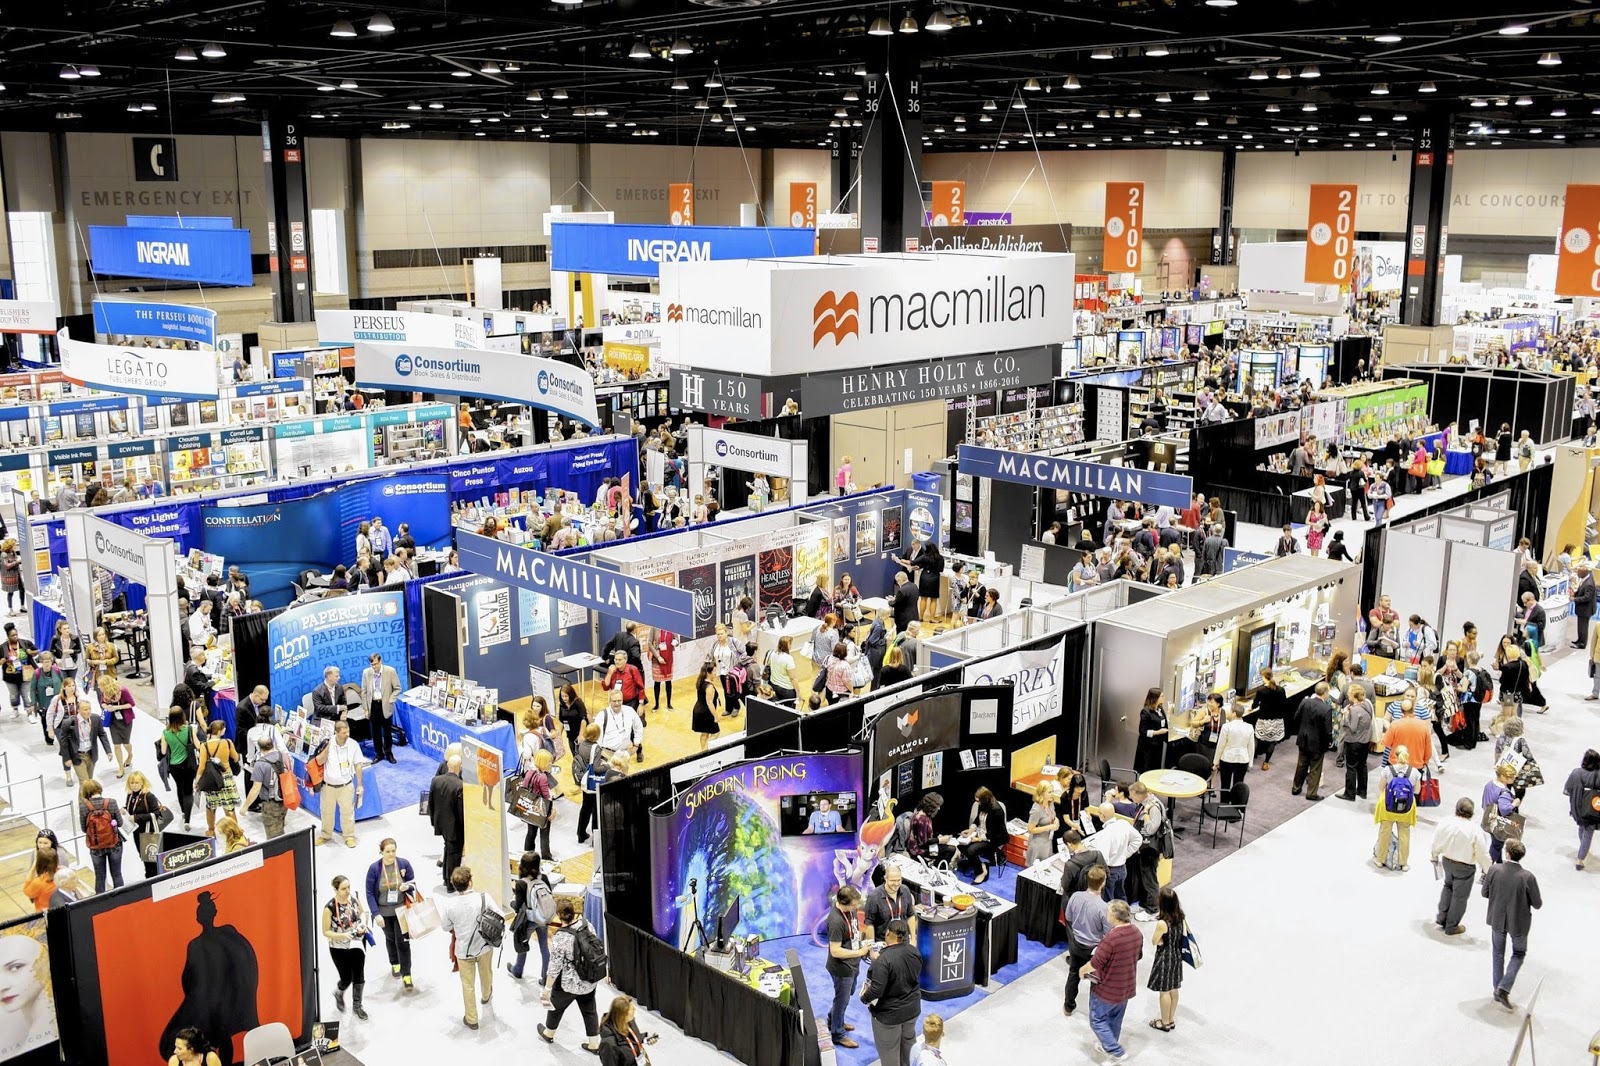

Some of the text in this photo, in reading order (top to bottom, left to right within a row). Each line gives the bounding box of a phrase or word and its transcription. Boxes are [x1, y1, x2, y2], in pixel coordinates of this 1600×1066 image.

[868, 81, 876, 94] H
[910, 81, 918, 95] H
[865, 99, 878, 113] 36
[908, 99, 920, 113] 36
[287, 125, 295, 134] D
[1423, 128, 1430, 138] H
[286, 136, 297, 146] 36
[1420, 140, 1431, 149] 32
[82, 190, 251, 206] EMERGENCY EXIT
[696, 189, 720, 200] EXIT
[1378, 194, 1396, 206] TO
[1480, 194, 1566, 208] CONCOURS
[1126, 187, 1140, 268] 2100
[1333, 190, 1352, 280] 2000
[137, 241, 190, 266] INGRAM
[627, 238, 710, 262] INGRAM
[870, 275, 1045, 334] macmillan
[135, 310, 204, 326] THE PERSEUS BOOKS
[354, 316, 405, 330] PERSEUS
[686, 306, 762, 329] macmillan
[355, 332, 406, 341] DISTRIBUTION
[108, 358, 168, 378] LEGATO
[414, 355, 480, 374] Consortium
[109, 374, 167, 388] PUBLISHERS GROUP
[414, 368, 426, 377] Book
[429, 370, 445, 379] Sales
[452, 372, 482, 382] Distribution
[842, 356, 1020, 394] HENRY HOLT & CO.
[550, 372, 583, 398] Consortium
[717, 378, 747, 399] 150
[843, 389, 916, 409] CELEBRATING
[921, 387, 936, 398] 150
[939, 383, 968, 397] YEARS
[712, 398, 750, 415] YEARS
[54, 452, 70, 460] Visible
[728, 444, 778, 463] Consortium
[452, 465, 495, 478] Cinco Puntos
[514, 466, 534, 474] Auzou
[998, 454, 1142, 496] MACMILLAN
[465, 477, 483, 486] Press
[132, 512, 178, 526] City Lights
[134, 523, 179, 535] Publishers
[106, 538, 144, 567] Consortium
[725, 564, 745, 576] WILLIAM
[761, 569, 790, 584] HEARTLESS
[496, 546, 642, 614] MACMILLAN
[725, 587, 736, 596] THE
[498, 591, 508, 634] WARRIOR
[274, 634, 310, 664] nbm
[422, 722, 449, 750] nbm
[888, 738, 928, 757] GRAYWOLF
[168, 855, 185, 867] Harry
[186, 848, 206, 863] Potter
[170, 878, 194, 891] Academy
[201, 870, 219, 881] Broken
